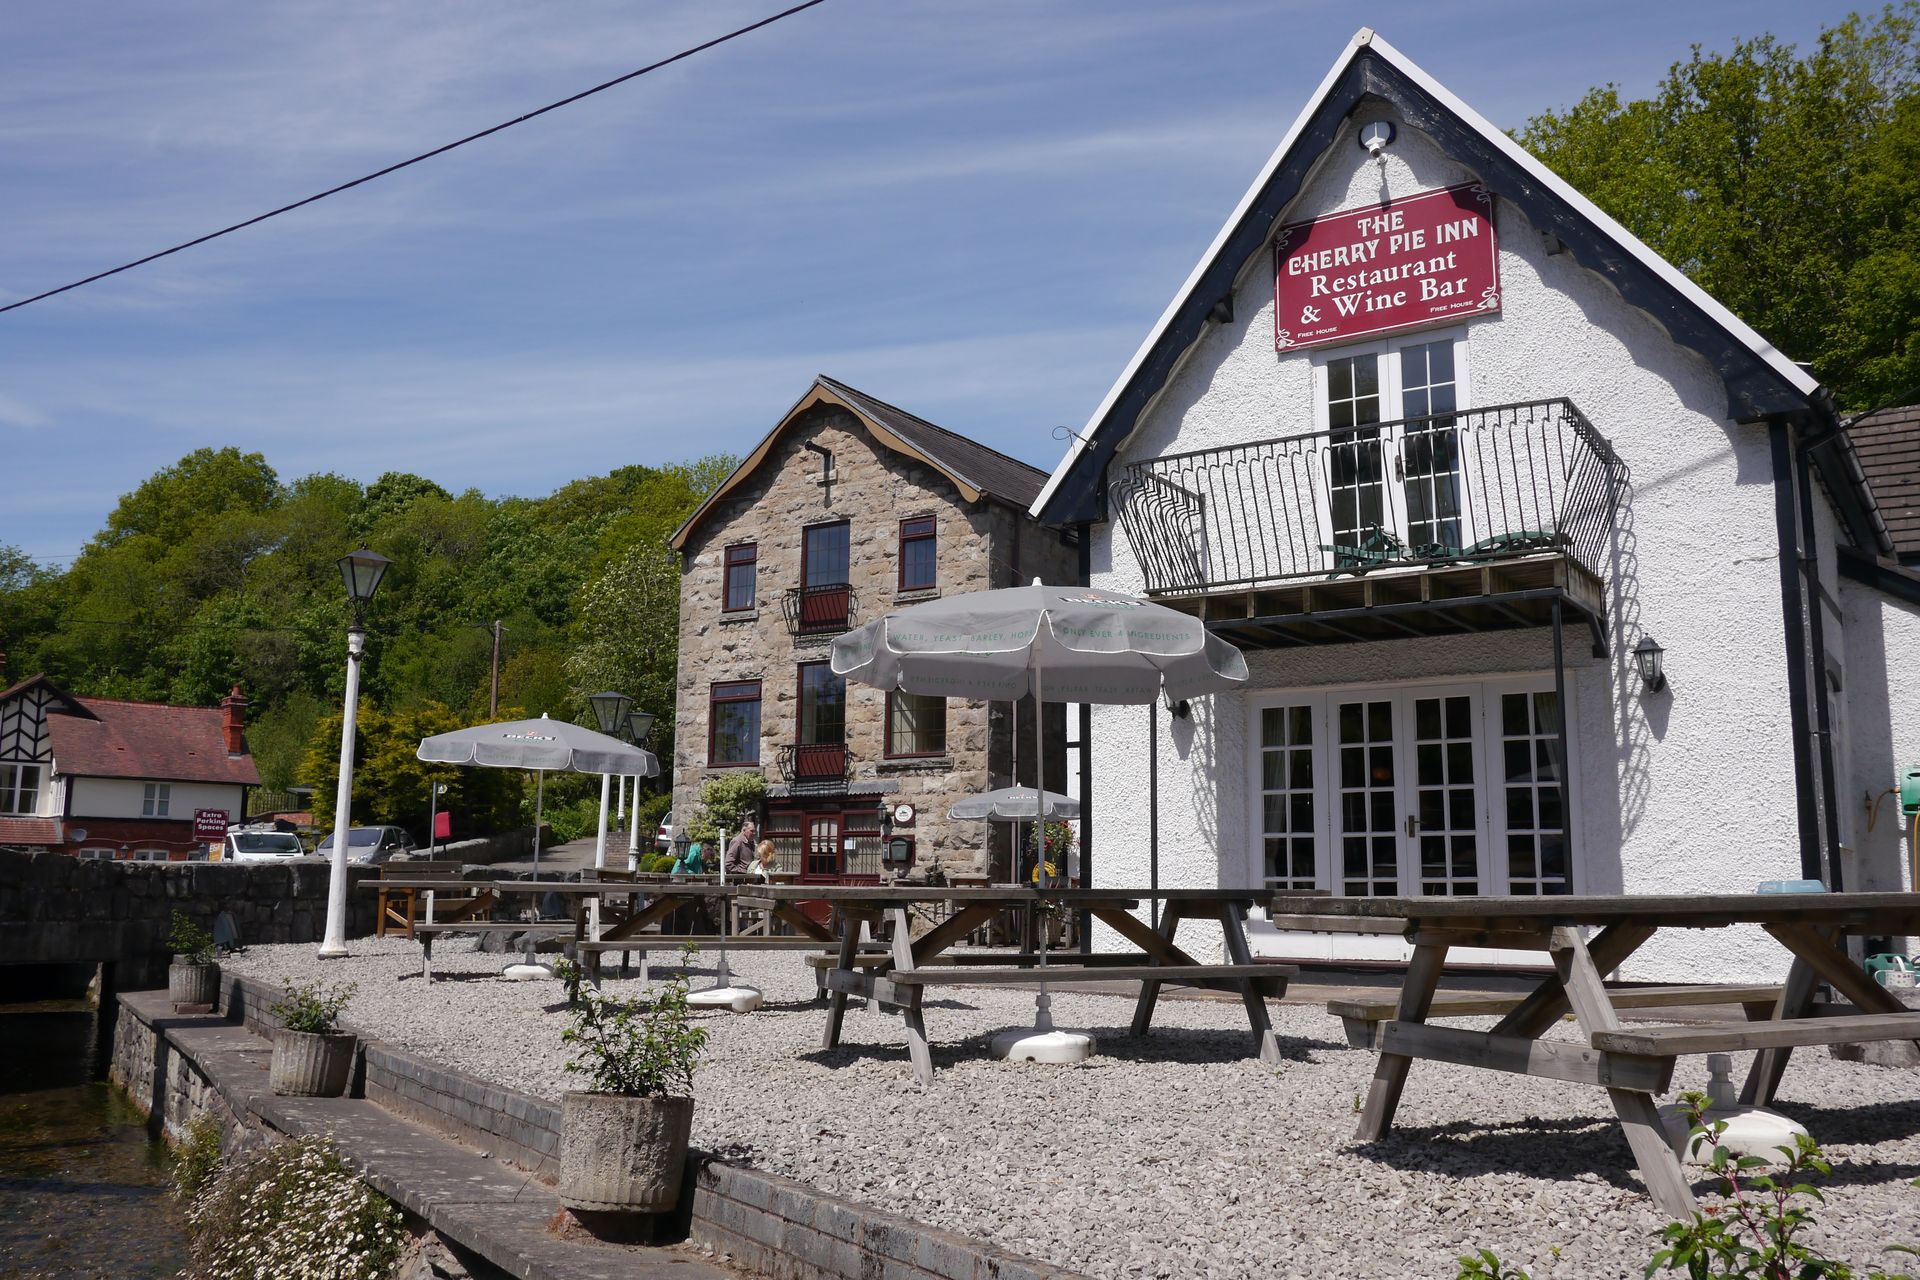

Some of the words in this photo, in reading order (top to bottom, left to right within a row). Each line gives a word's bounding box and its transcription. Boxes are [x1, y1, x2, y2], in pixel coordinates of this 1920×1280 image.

[1357, 210, 1405, 238] THE
[1288, 239, 1380, 276] CHERRY
[1390, 229, 1426, 254] PIE
[1436, 217, 1479, 244] INN
[1310, 251, 1457, 298] Restaurant
[1301, 305, 1321, 324] &
[1332, 289, 1407, 318] Wine
[1420, 277, 1468, 302] Bar
[1430, 305, 1448, 313] FREE
[1450, 300, 1474, 309] HOUSE
[1297, 330, 1314, 339] FREE
[1316, 326, 1337, 335] HOUSE
[1088, 630, 1113, 638] EVER
[196, 817, 226, 825] Parking
[197, 823, 224, 831] Spaces
